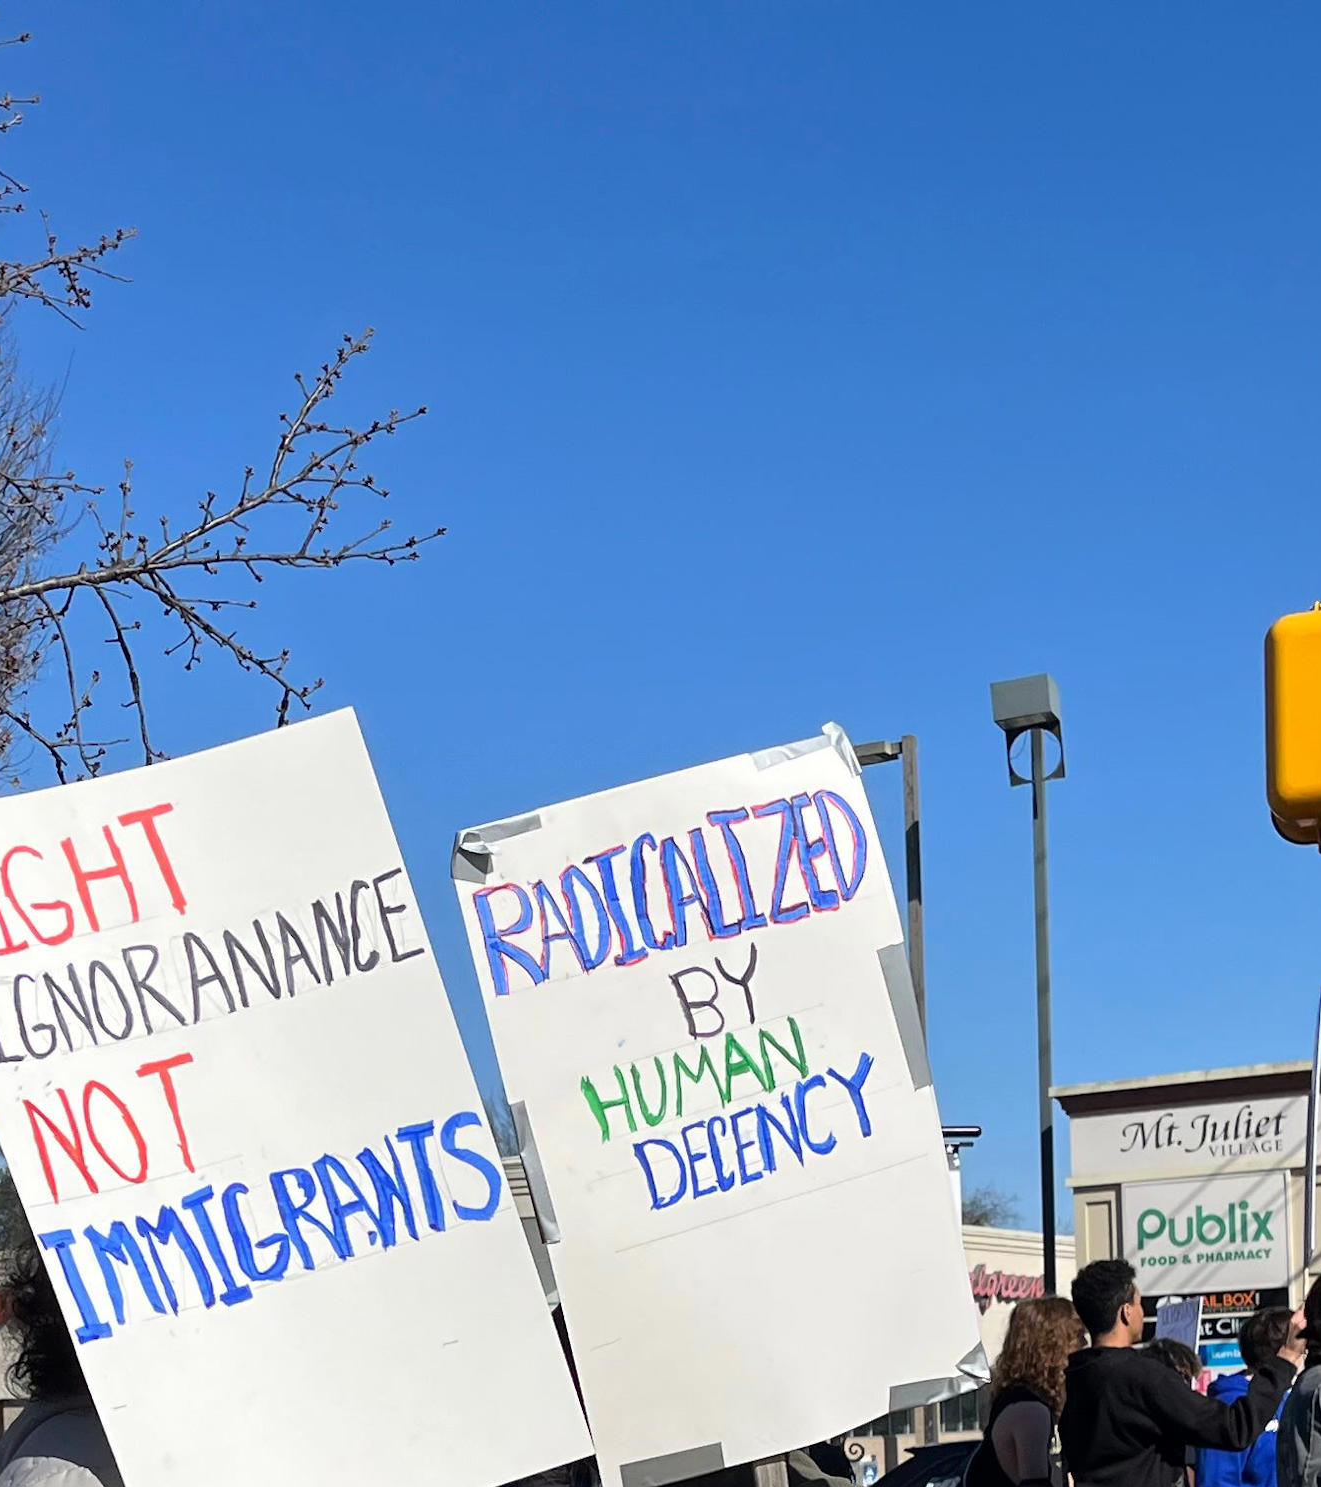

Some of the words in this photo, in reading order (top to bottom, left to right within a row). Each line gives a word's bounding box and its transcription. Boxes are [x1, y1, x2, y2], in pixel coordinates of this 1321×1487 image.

[474, 790, 867, 997] RADICALIZED
[669, 943, 758, 1040] BY
[580, 1016, 809, 1143] HUMAN
[22, 1054, 194, 1204] NOT
[632, 1052, 874, 1210] DECENCY
[1120, 1112, 1182, 1153] Mt.
[1184, 1105, 1288, 1153] Juliet
[1209, 1139, 1283, 1157] VILLAGE
[38, 1112, 503, 1344] IMMIGRANTS
[1137, 1200, 1274, 1250] Publix
[1140, 1255, 1177, 1267] FOOD
[1182, 1254, 1191, 1264] &
[1197, 1248, 1272, 1264] PHARMACY
[1202, 1294, 1222, 1308] AIL
[1223, 1290, 1255, 1307] BOX
